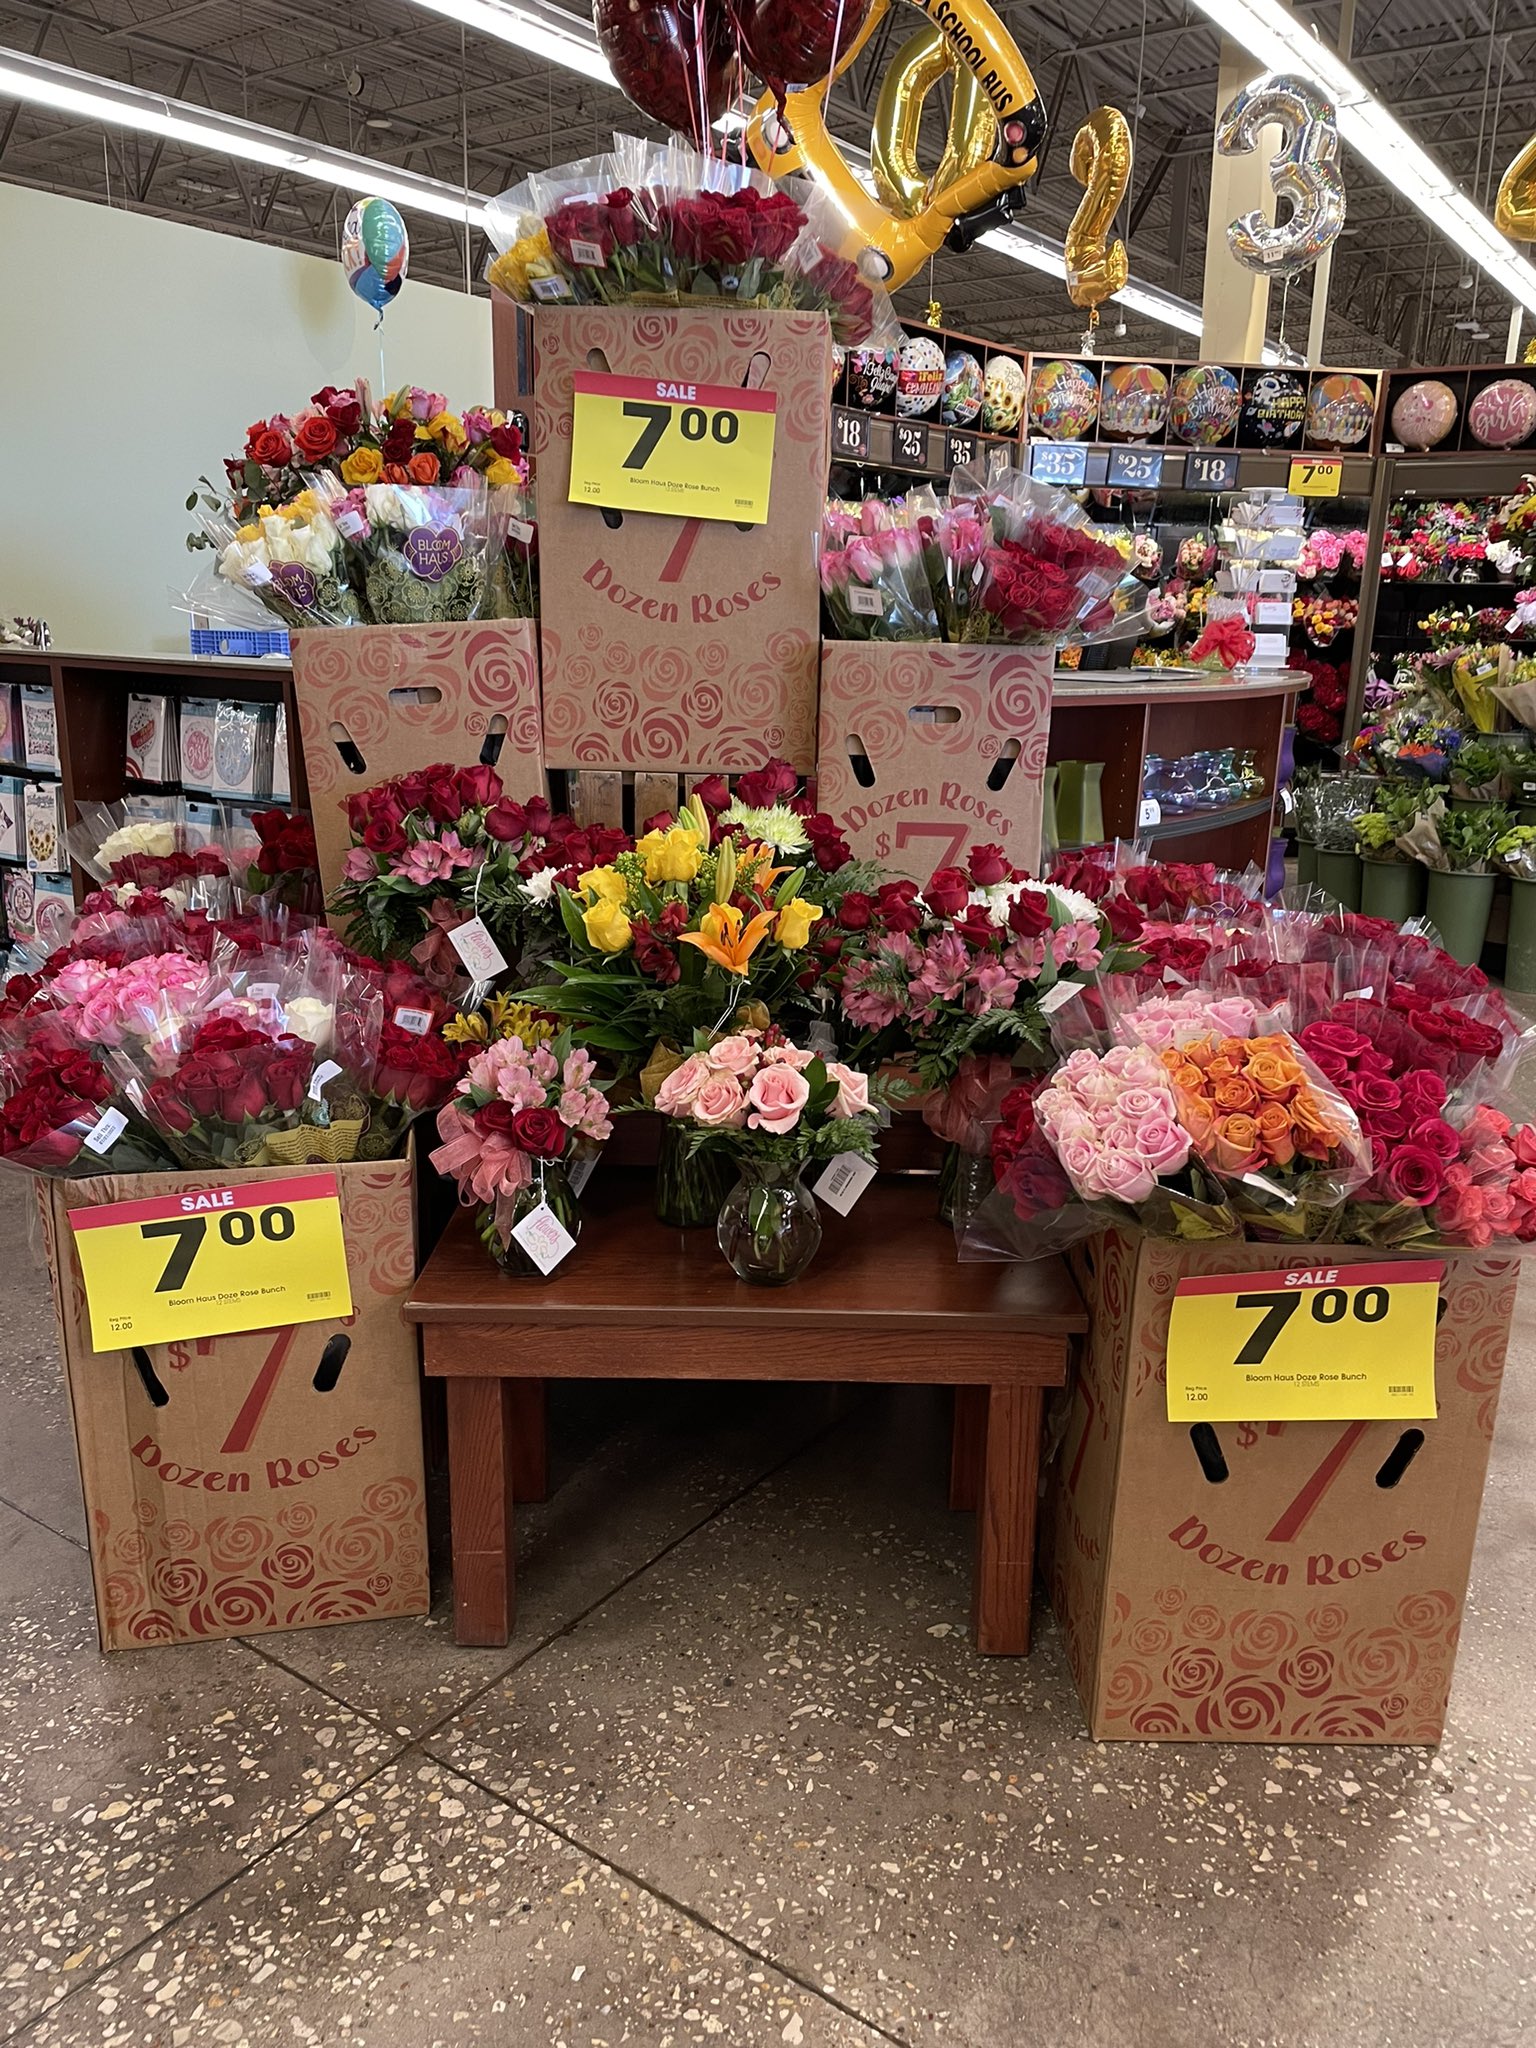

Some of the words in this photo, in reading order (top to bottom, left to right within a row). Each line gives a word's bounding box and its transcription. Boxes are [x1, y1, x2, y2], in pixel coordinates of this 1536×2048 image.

[932, 1, 987, 71] SCHOOL
[656, 382, 697, 400] SALE
[838, 416, 861, 447] $18
[899, 428, 922, 457] $25
[951, 438, 972, 465] $35
[1041, 452, 1075, 475] $35
[1118, 454, 1152, 479] $25
[1194, 458, 1226, 482] $18
[583, 486, 600, 494] 12.00
[583, 558, 678, 622] Dozen
[692, 571, 781, 623] Roses
[840, 787, 928, 833] Dozen
[939, 781, 1013, 837] Roses
[180, 1190, 235, 1212] SALE
[1284, 1270, 1339, 1286] SALE
[168, 1297, 195, 1307] Bloom
[196, 1294, 216, 1303] Haus
[218, 1291, 239, 1301] Doze
[240, 1288, 260, 1298] Rose
[261, 1286, 286, 1295] Bunch
[110, 1322, 133, 1332] 12.00
[1246, 1373, 1272, 1382] Bloom
[1274, 1373, 1294, 1382] Haus
[1296, 1373, 1317, 1382] Doze
[1319, 1373, 1339, 1382] Rose
[1341, 1372, 1367, 1381] Bunch
[1186, 1393, 1208, 1401] 12.00
[131, 1435, 250, 1492] Dozen
[266, 1425, 377, 1489] Roses
[1168, 1515, 1289, 1586] Dozen
[1306, 1530, 1427, 1586] Roses
